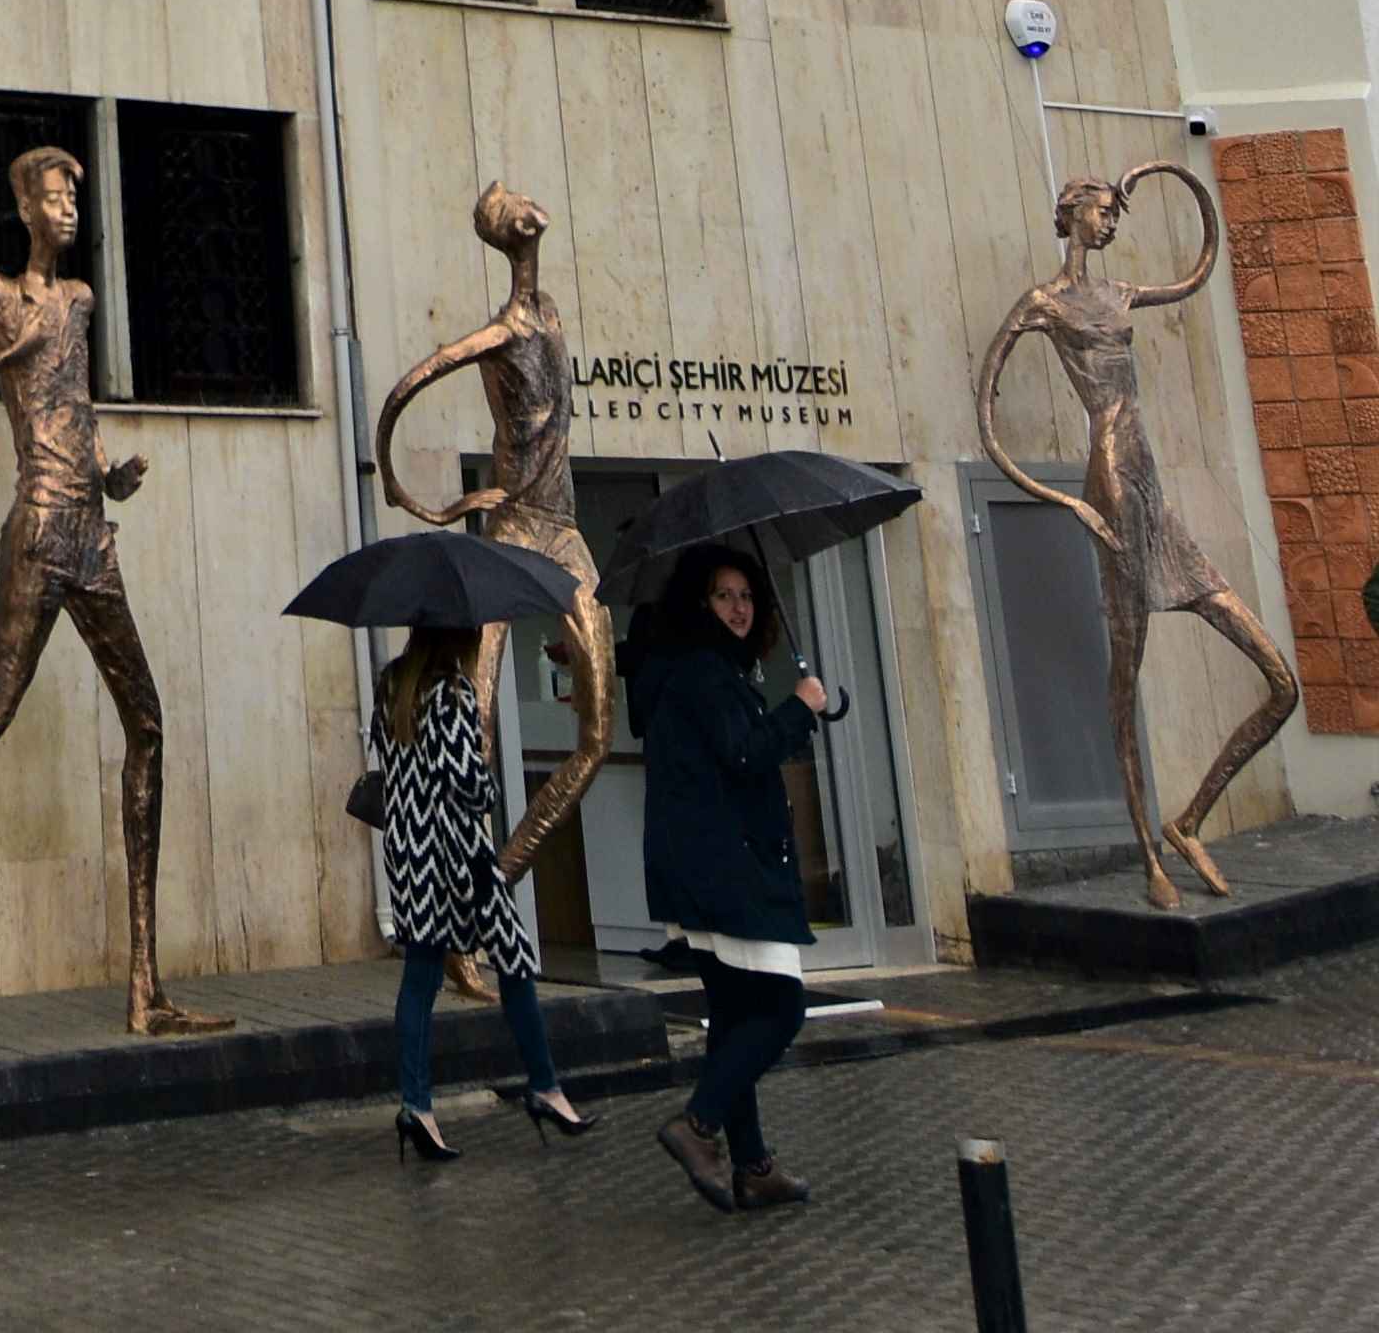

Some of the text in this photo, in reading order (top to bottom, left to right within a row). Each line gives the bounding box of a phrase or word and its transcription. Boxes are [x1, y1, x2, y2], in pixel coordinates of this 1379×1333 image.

[572, 351, 849, 396] LARİÇİ ŞEHİR MÜZESİ
[571, 399, 853, 426] LLED CITY MUSEUM
